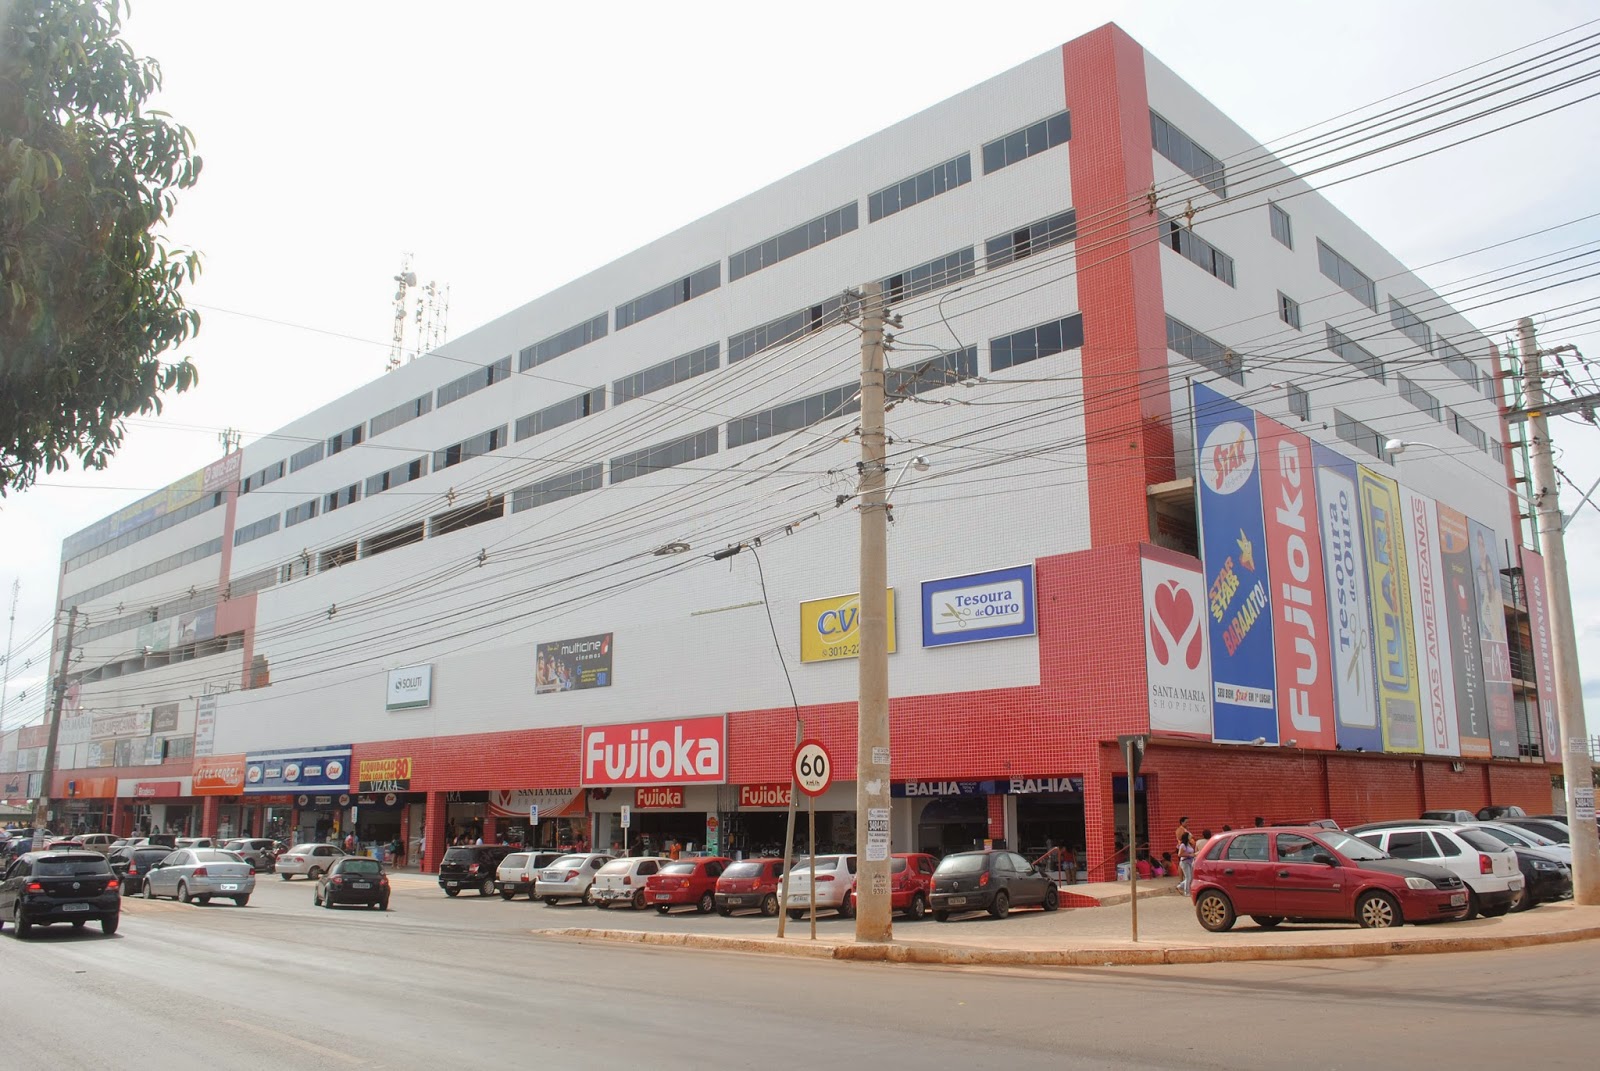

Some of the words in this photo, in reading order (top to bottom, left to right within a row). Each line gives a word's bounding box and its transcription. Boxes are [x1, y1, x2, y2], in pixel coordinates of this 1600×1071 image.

[1339, 490, 1354, 577] Ouro
[1276, 439, 1321, 733] Fujioka
[1329, 502, 1350, 652] Tesoura
[1414, 498, 1437, 660] AMERICANAS
[955, 590, 1013, 607] Tesoura
[1349, 579, 1356, 601] de
[975, 608, 984, 616] de
[985, 602, 1020, 616] Ouro
[1223, 580, 1268, 656] BARAAATO!
[817, 607, 860, 635] CV
[561, 640, 601, 655] multicine
[1461, 614, 1477, 735] multicine
[1152, 684, 1179, 699] SANTA
[1180, 688, 1206, 702] MARIA
[1153, 699, 1207, 713] SHOPPING
[1430, 668, 1446, 749] LOJAS
[586, 725, 719, 780] Fujioka
[395, 758, 409, 779] 80
[801, 754, 825, 777] 60
[370, 780, 398, 792] VIZARA
[742, 785, 792, 805] Fujioka
[905, 782, 960, 796] BAHIA
[1010, 778, 1074, 793] BAHIA
[637, 788, 681, 806] Fujioka
